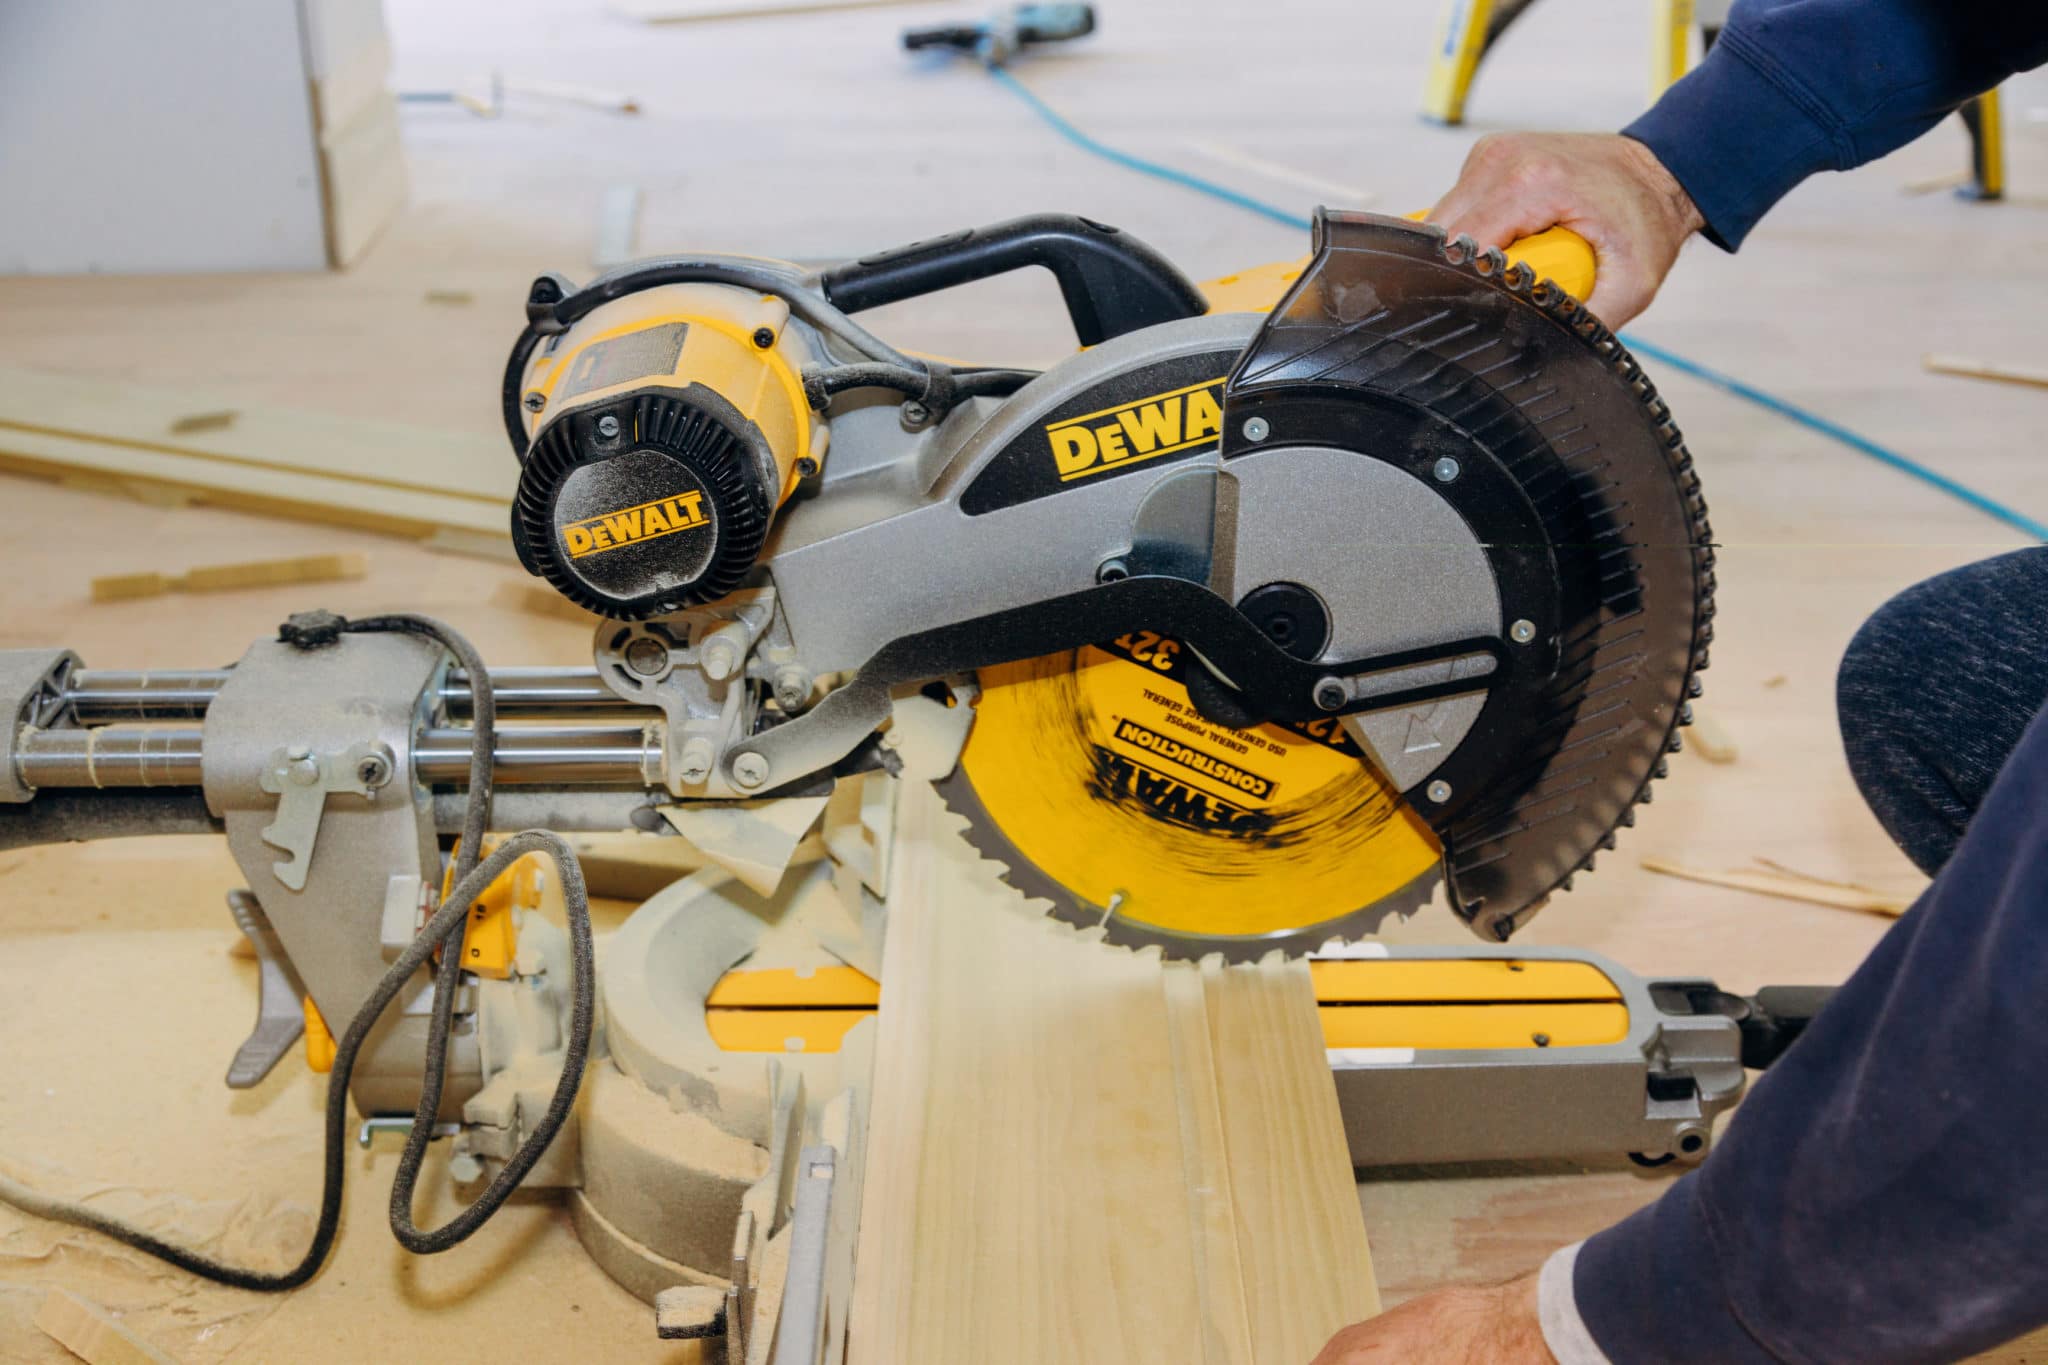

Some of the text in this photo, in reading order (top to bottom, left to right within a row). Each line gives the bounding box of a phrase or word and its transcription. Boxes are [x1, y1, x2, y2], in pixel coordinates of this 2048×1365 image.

[1048, 385, 1224, 475] DEWA
[562, 492, 704, 556] DEWALT
[1120, 723, 1267, 795] CONSTRUCTION
[1165, 713, 1249, 754] GENERAL PURPOSE
[1267, 743, 1287, 757] USO
